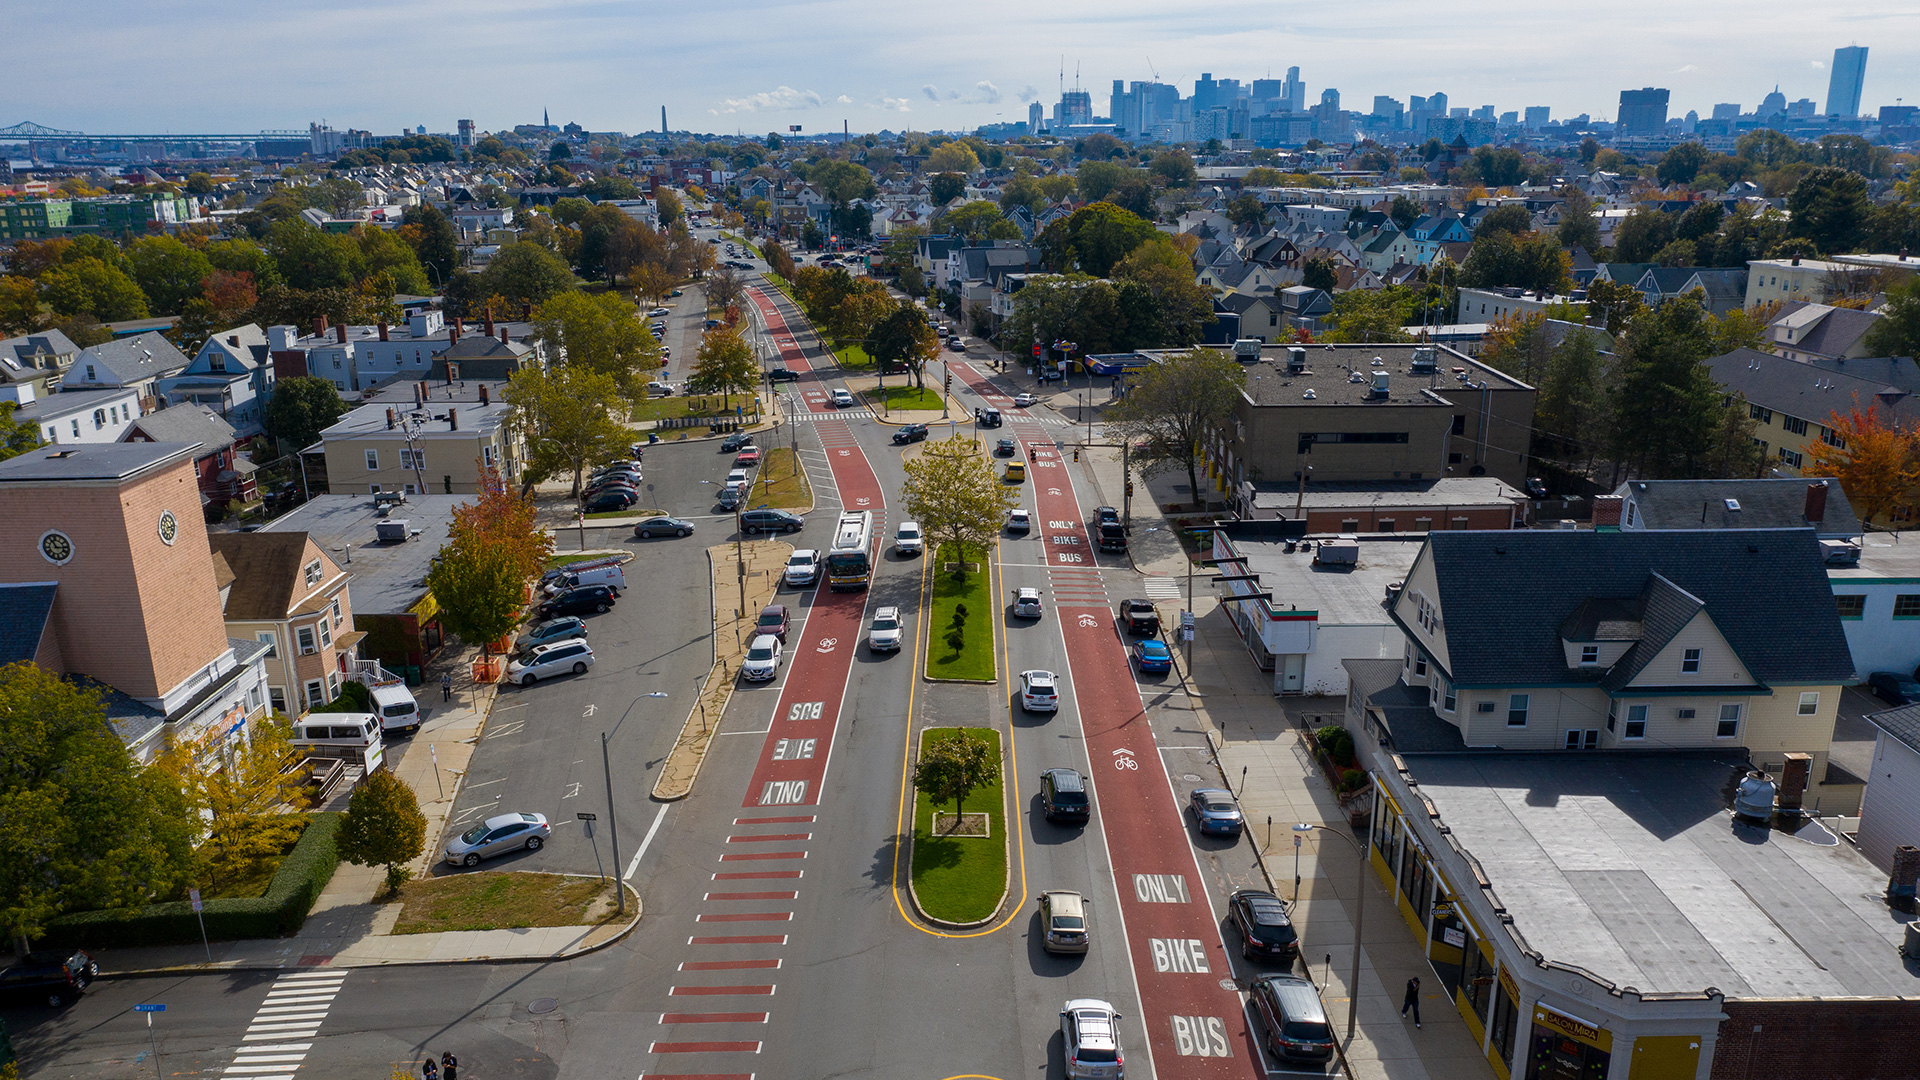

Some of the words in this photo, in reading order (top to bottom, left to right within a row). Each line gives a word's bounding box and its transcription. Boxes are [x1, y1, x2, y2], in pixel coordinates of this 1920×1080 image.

[1038, 460, 1056, 468] BUS
[1049, 520, 1074, 529] ONLY
[1053, 535, 1079, 545] BIKE
[1059, 552, 1082, 563] BUS
[790, 702, 823, 720] BUS
[762, 781, 805, 804] ONLY
[1136, 874, 1186, 903] ONLY
[1151, 938, 1209, 974] BIKE
[1173, 1015, 1228, 1058] BUS
[1548, 1014, 1574, 1030] SALON
[1574, 1023, 1596, 1040] MIRA
